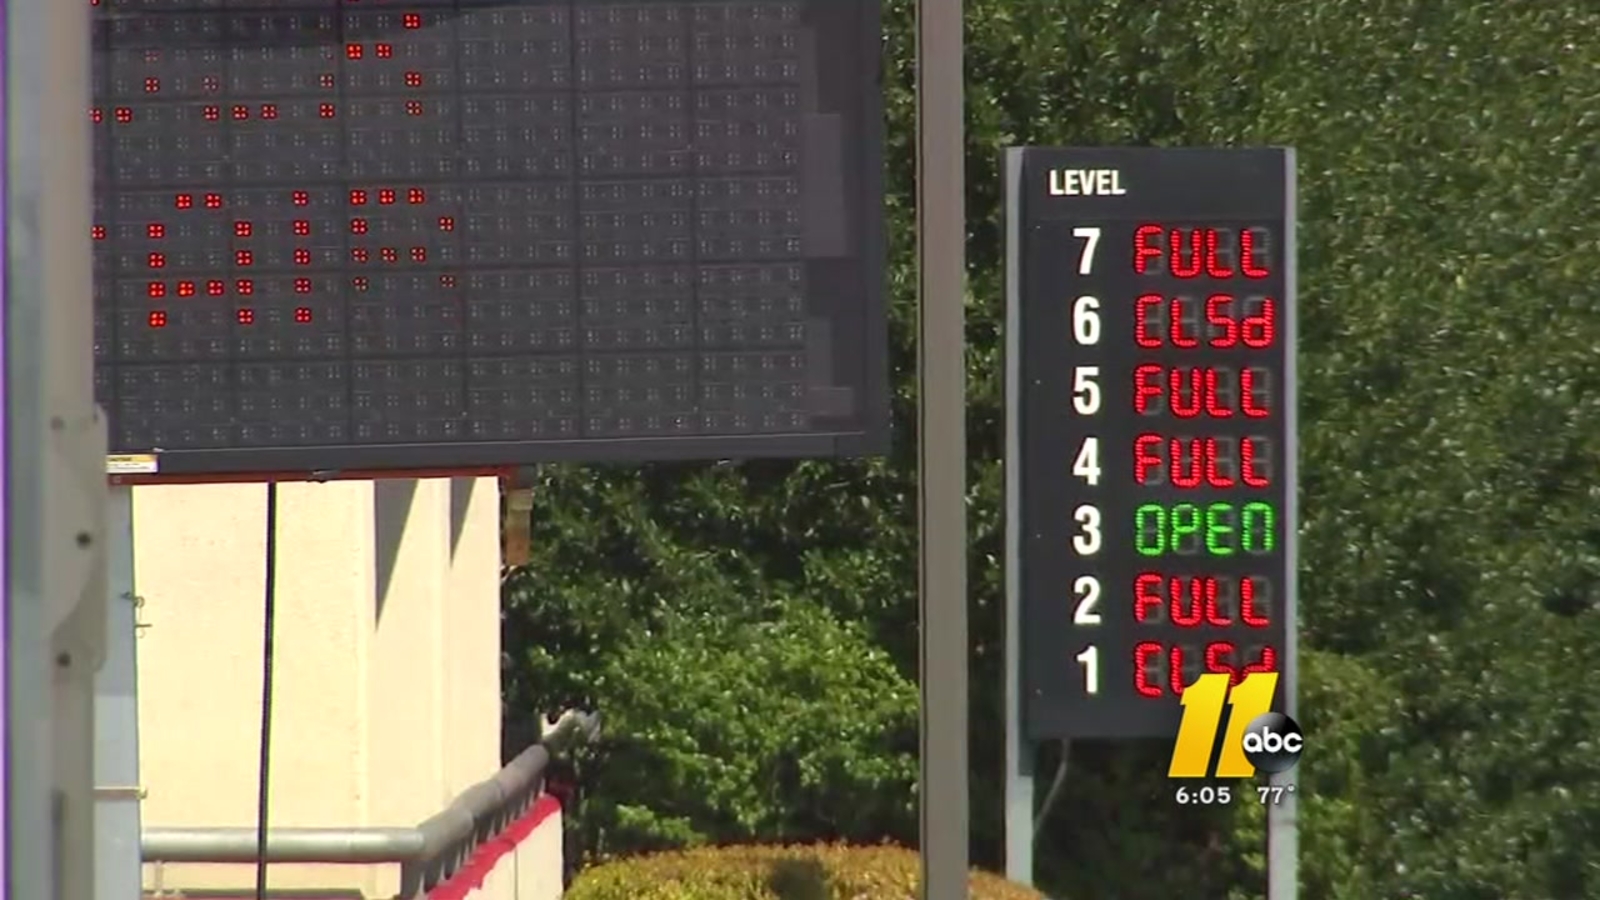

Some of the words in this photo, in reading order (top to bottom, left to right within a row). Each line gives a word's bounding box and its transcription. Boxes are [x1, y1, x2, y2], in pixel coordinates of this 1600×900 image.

[1049, 169, 1127, 196] LEVEL
[1072, 227, 1102, 275] 7
[1134, 224, 1270, 279] FULL
[1072, 296, 1102, 346] 6
[1072, 366, 1102, 415] 5
[1134, 363, 1270, 419] FULL
[1072, 437, 1102, 486] 4
[1134, 432, 1270, 489] FULL
[1072, 504, 1102, 556] 3
[1134, 502, 1276, 557] OPEN
[1072, 575, 1102, 625] 2
[1134, 571, 1270, 628] FULL
[1076, 645, 1099, 694] 1
